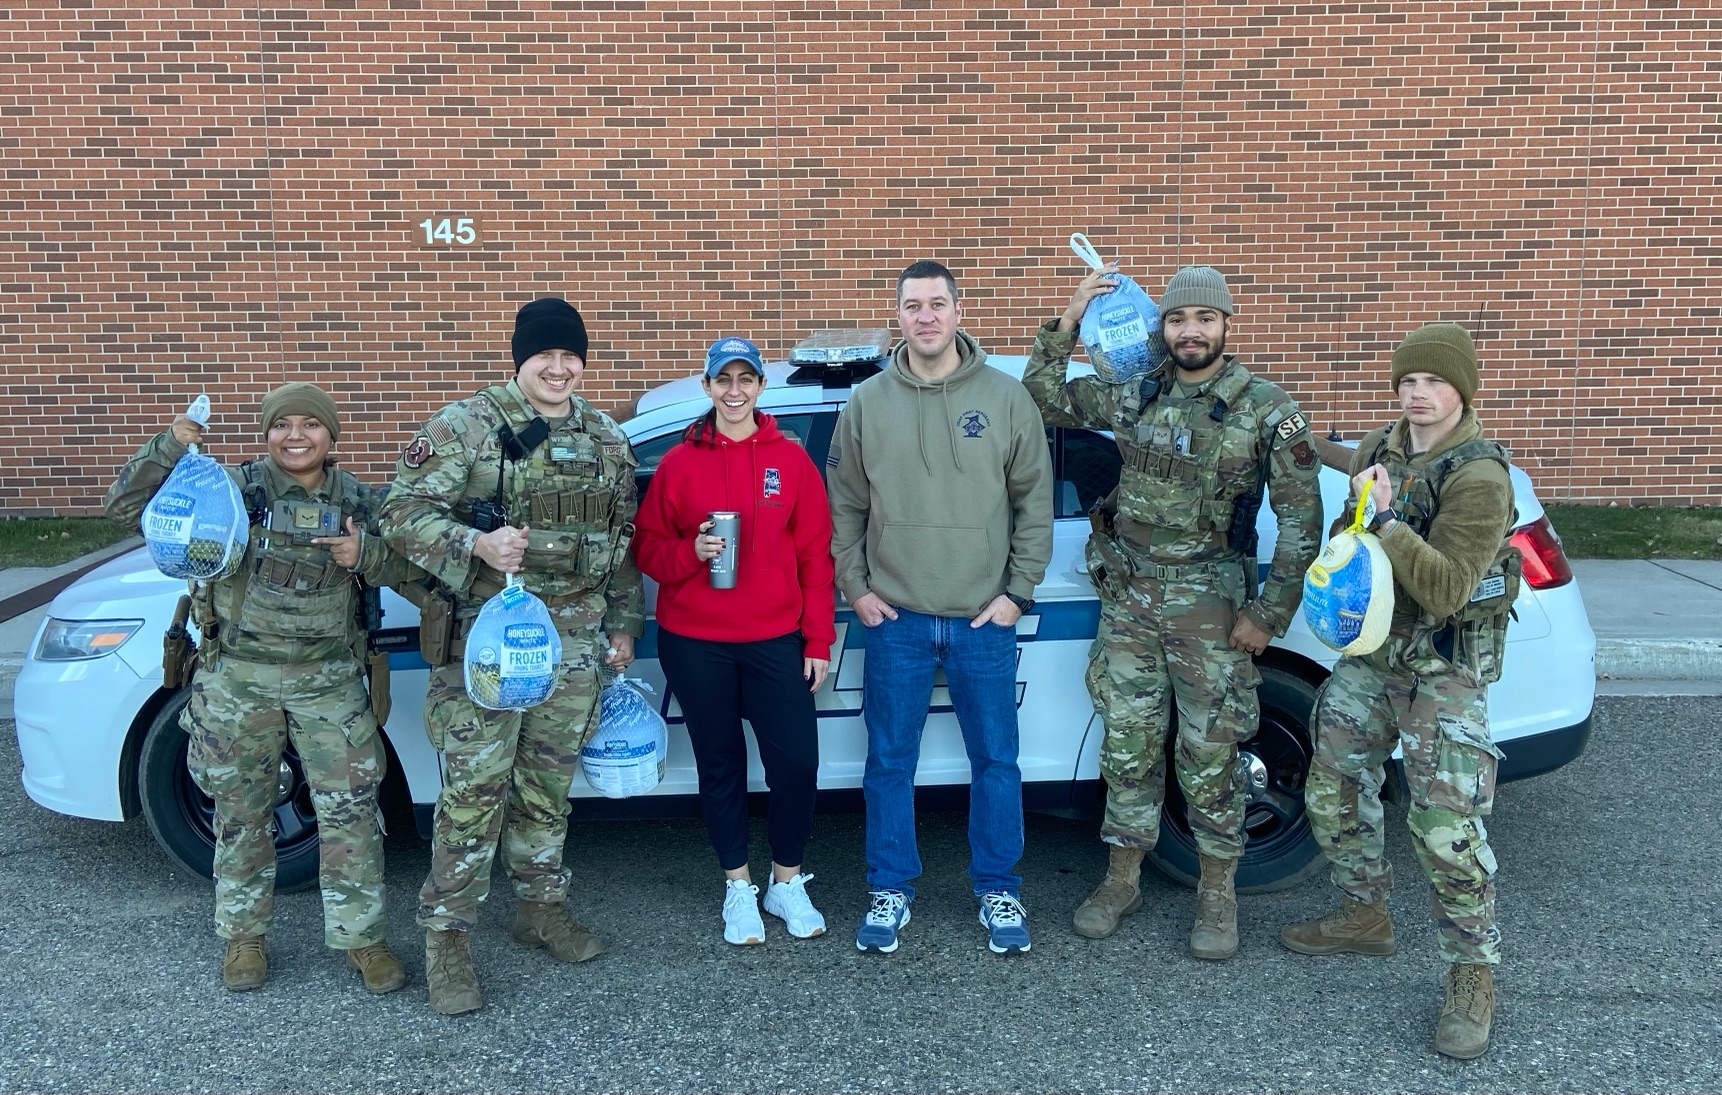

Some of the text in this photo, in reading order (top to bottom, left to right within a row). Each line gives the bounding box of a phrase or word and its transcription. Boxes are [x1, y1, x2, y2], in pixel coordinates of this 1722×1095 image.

[419, 218, 476, 244] 145
[1105, 322, 1140, 341] FROZEN
[1280, 415, 1300, 435] SF
[150, 516, 182, 532] FROZEN
[509, 650, 547, 665] FROZEN
